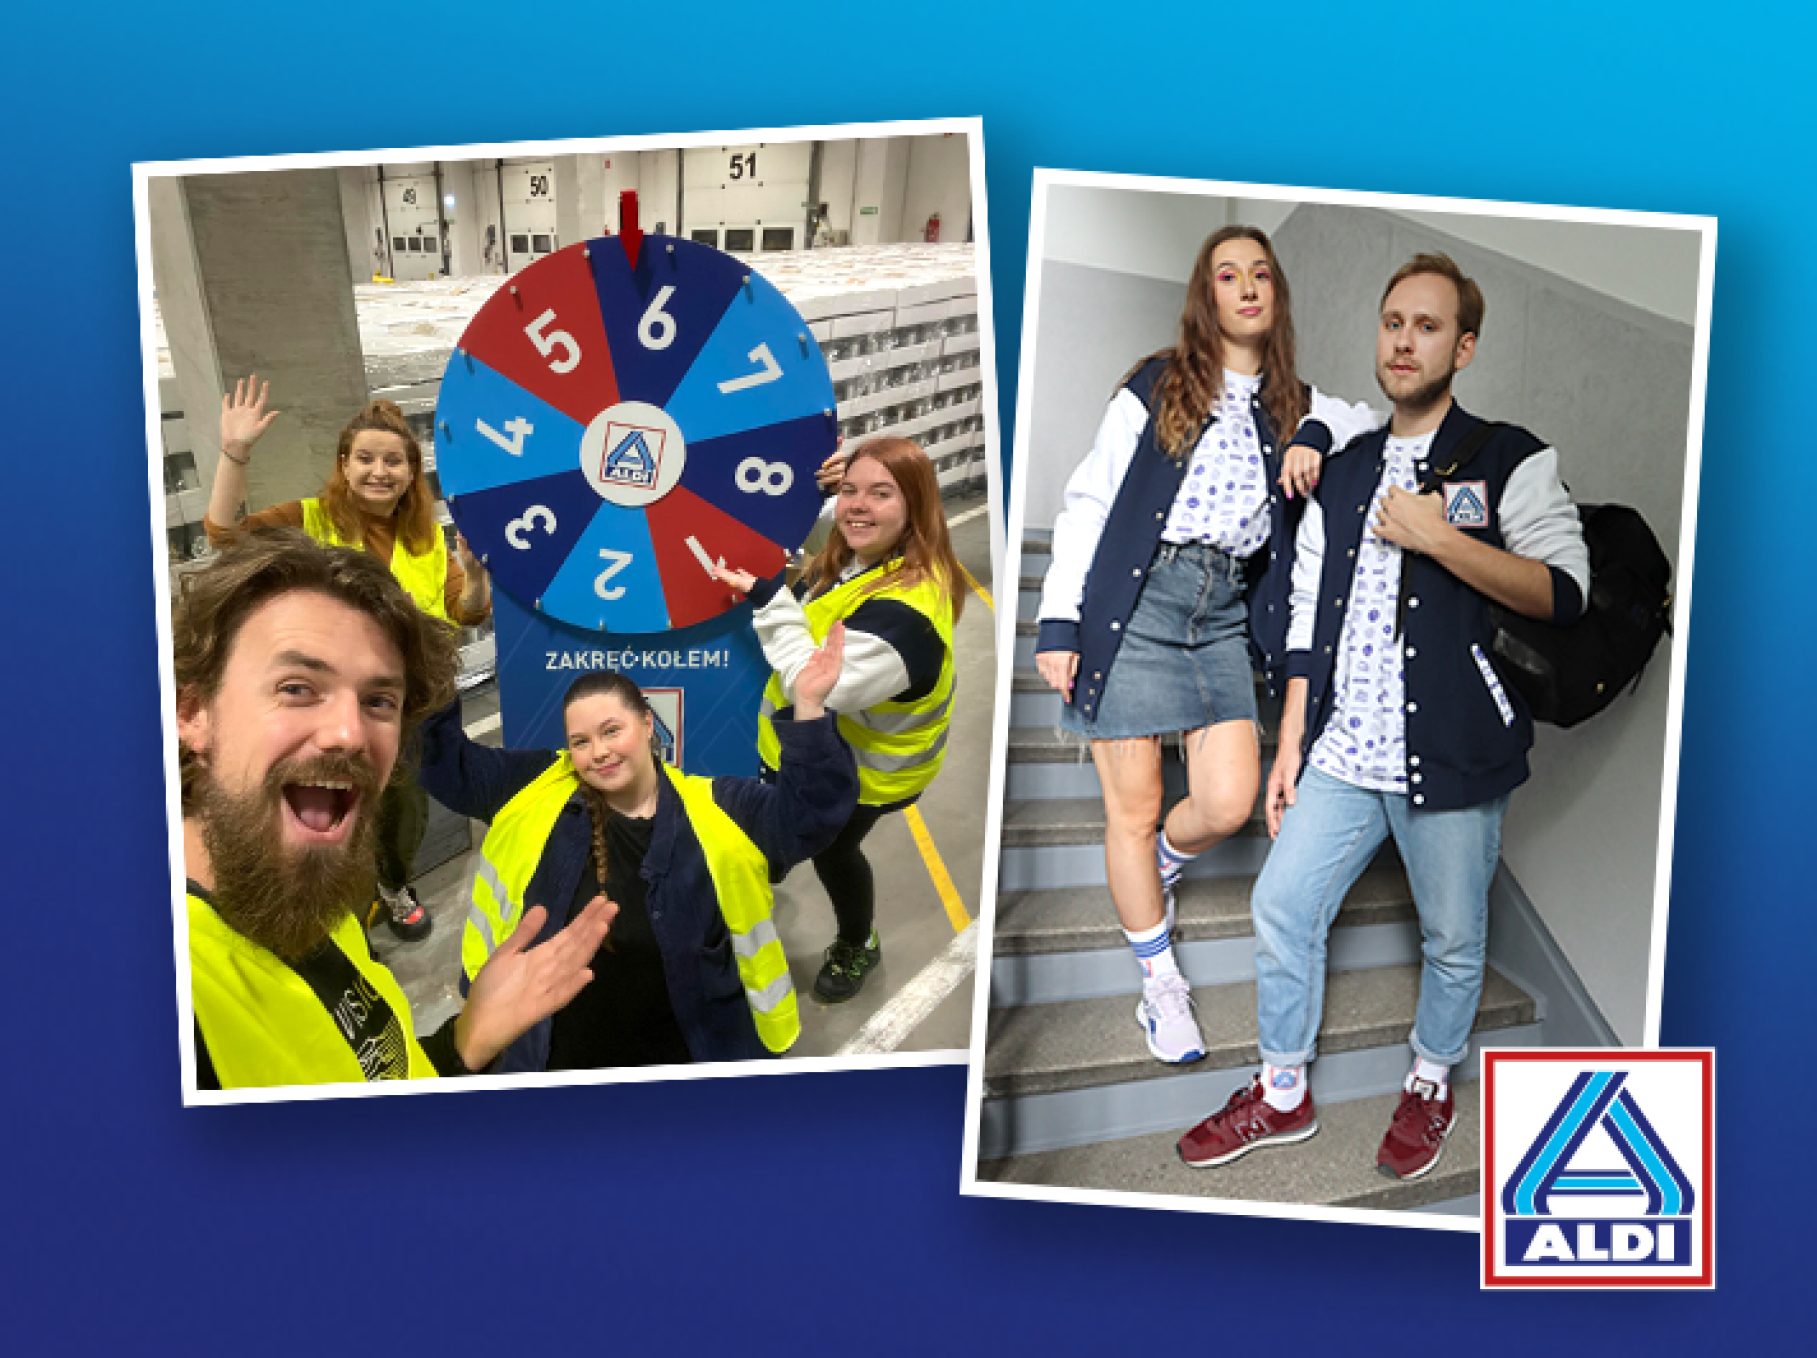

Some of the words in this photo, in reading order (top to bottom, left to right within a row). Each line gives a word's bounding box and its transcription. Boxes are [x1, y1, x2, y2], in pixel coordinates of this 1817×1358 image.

[530, 175, 549, 197] 50
[729, 152, 756, 180] 51
[637, 285, 678, 350] 6
[523, 308, 583, 374] 5
[716, 341, 784, 394] 7
[475, 416, 534, 458] 4
[734, 456, 795, 496] 8
[504, 504, 558, 550] 3
[593, 548, 634, 601] 2
[641, 650, 731, 670] KOŁEM!
